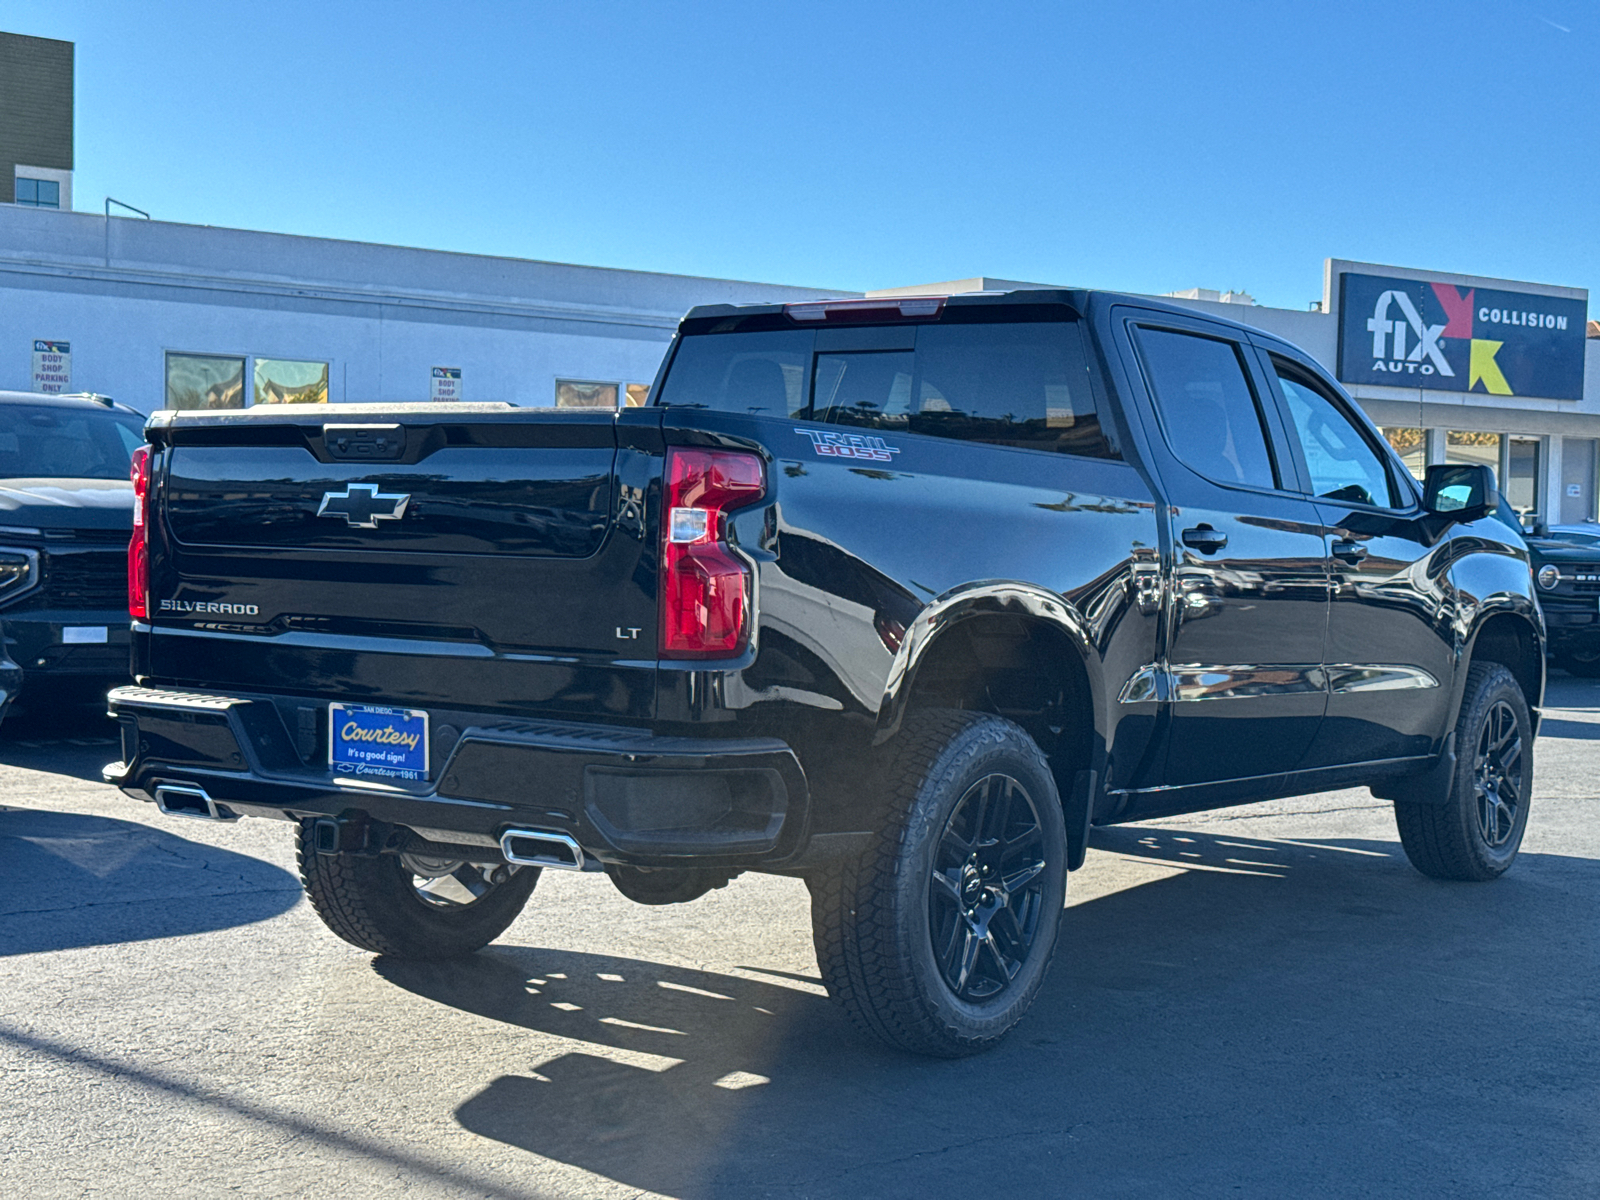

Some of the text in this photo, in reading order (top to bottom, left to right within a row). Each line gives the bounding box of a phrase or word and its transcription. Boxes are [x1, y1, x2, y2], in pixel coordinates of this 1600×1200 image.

[1478, 307, 1568, 331] COLLISION
[1367, 290, 1455, 377] fix
[41, 354, 62, 362] BODY
[41, 364, 62, 372] SHOP
[1372, 360, 1435, 375] AUTO
[35, 373, 69, 383] PARKING
[42, 383, 62, 392] ONLY
[438, 388, 455, 396] SHOP
[794, 428, 900, 453] TRAIL
[814, 443, 892, 462] BOSS
[160, 599, 259, 615] SILVERADO
[616, 626, 642, 639] LT
[363, 705, 393, 715] SAN DIEGO
[341, 721, 420, 751] Courtesy
[348, 747, 359, 757] It's
[365, 750, 386, 761] good
[386, 751, 406, 764] sign!
[355, 762, 418, 780] Courtesy 1961
